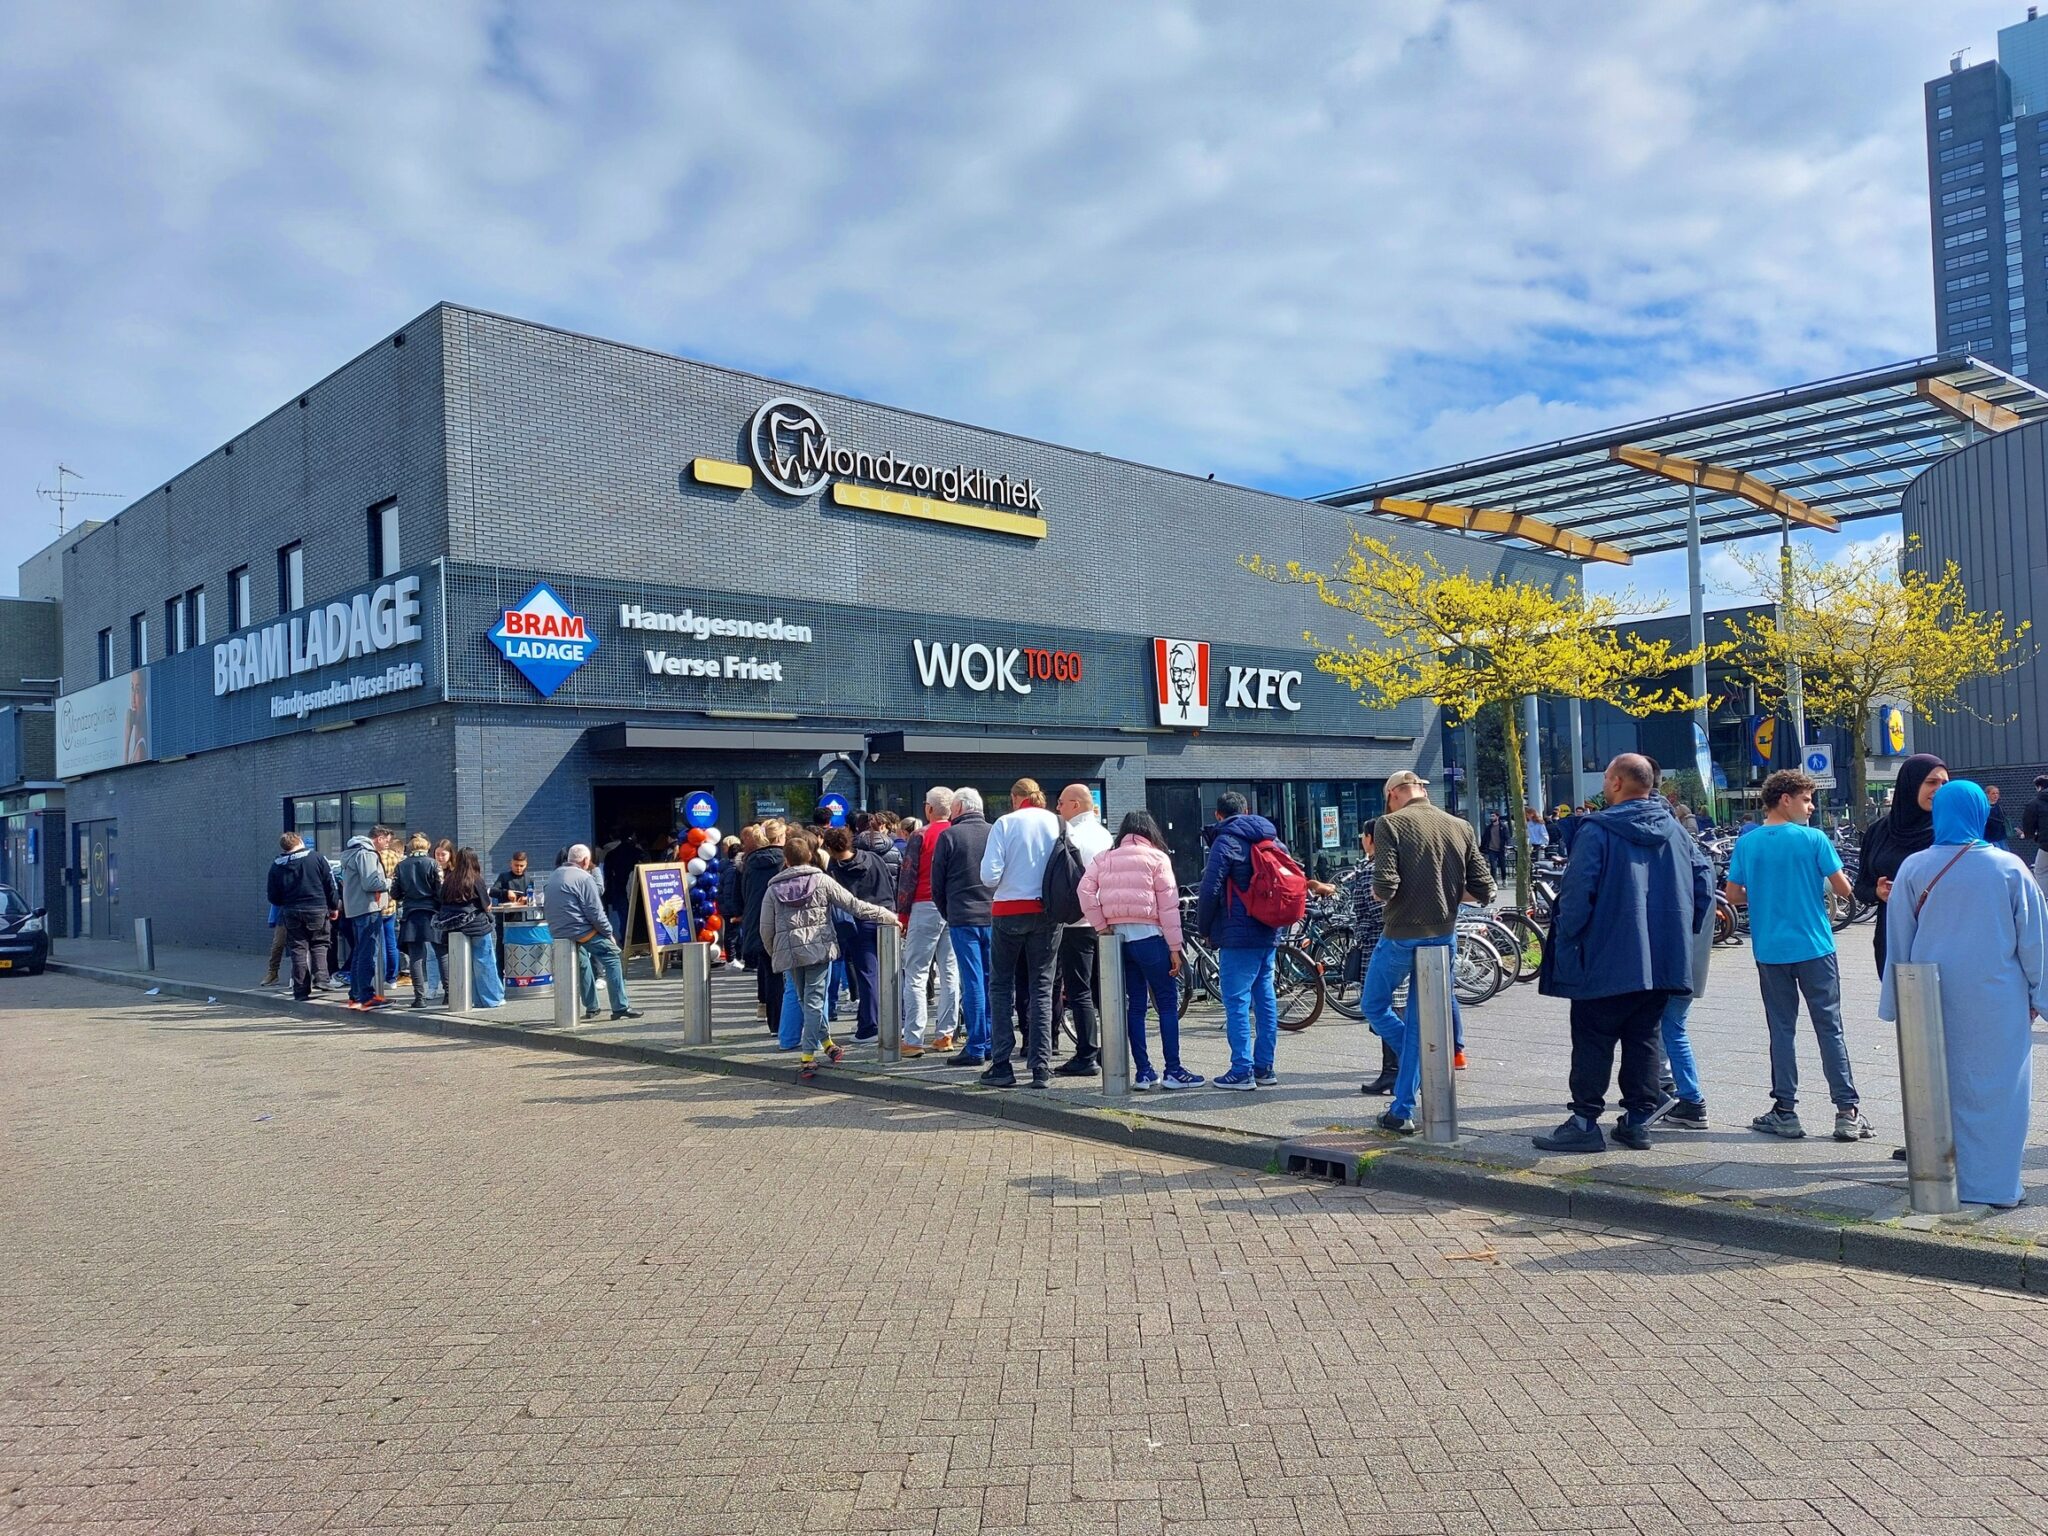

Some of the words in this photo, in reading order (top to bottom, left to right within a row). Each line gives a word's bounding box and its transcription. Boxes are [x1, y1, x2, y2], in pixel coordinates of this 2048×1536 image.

[803, 432, 1043, 510] Mondzorgkliniek
[837, 487, 932, 516] ASKAR
[214, 622, 290, 696] BRAM
[290, 575, 422, 675] LADAGE
[505, 610, 584, 639] BRAM
[618, 603, 812, 643] Handgesneden
[506, 640, 584, 662] LADAGE
[645, 650, 720, 678] Verse
[723, 656, 782, 682] Friet
[913, 639, 1031, 694] WOK
[271, 681, 351, 719] Handgesneden
[350, 674, 387, 702] Verse
[386, 662, 424, 692] Friet
[1225, 666, 1302, 711] KFC
